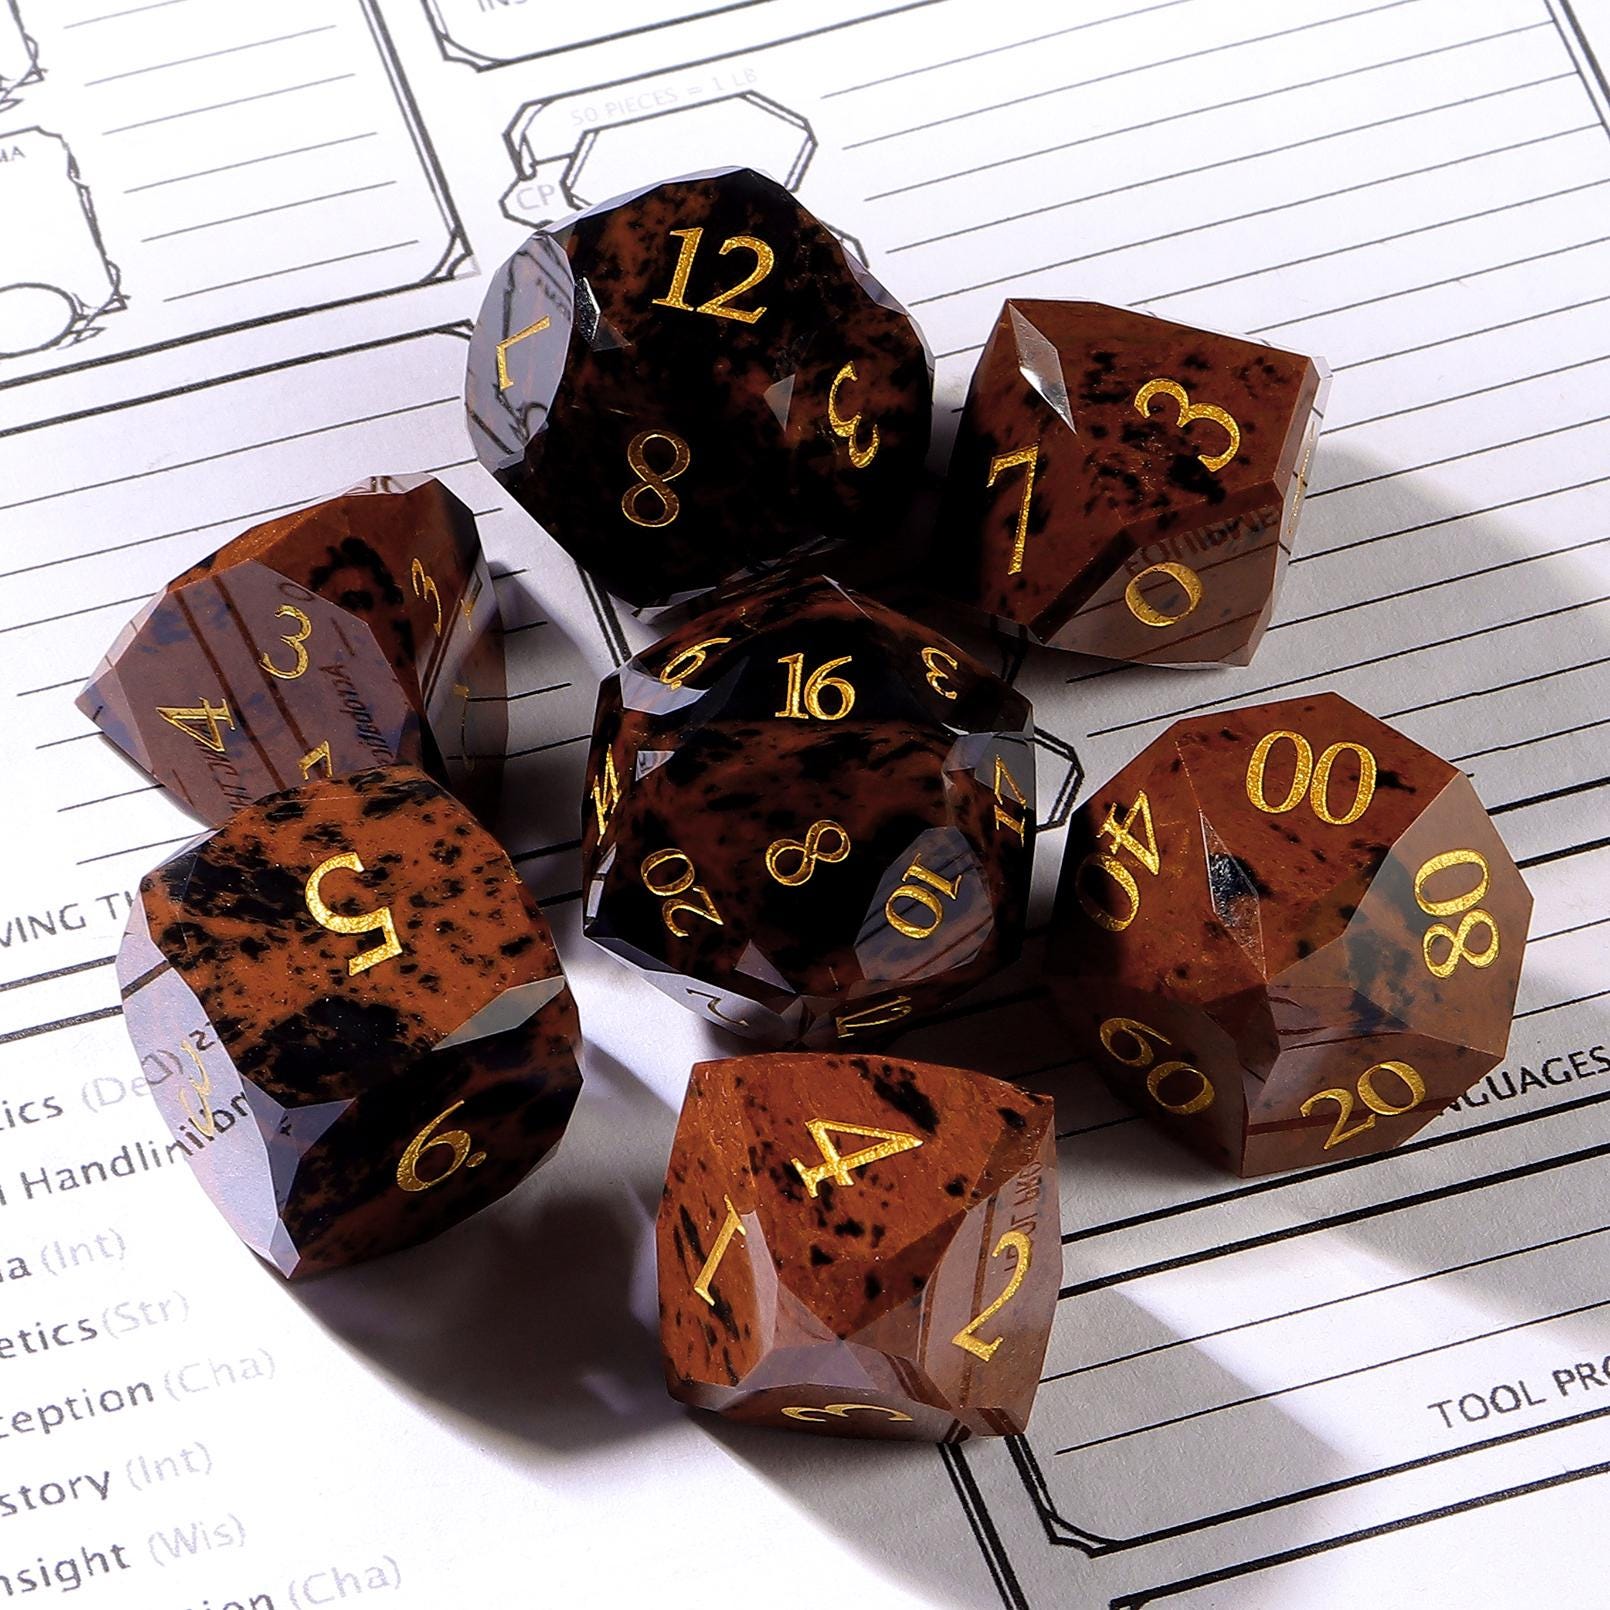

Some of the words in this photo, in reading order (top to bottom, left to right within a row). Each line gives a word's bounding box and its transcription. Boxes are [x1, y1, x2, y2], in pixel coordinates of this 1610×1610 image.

[603, 86, 679, 118] PIECES
[712, 75, 726, 93] 1
[731, 67, 758, 88] LB
[516, 184, 556, 211] CP
[652, 226, 775, 324] 12
[828, 360, 880, 468] 3
[1133, 377, 1241, 472] 3
[621, 430, 690, 528] 8
[986, 444, 1040, 576] 7
[411, 557, 442, 638] 3
[259, 604, 312, 680] 3
[920, 646, 958, 699] 3
[156, 697, 236, 753] 4
[774, 652, 855, 721] 16
[1245, 730, 1378, 826] 00
[765, 819, 851, 886] 8
[1074, 790, 1162, 933] 40
[305, 852, 403, 977] 5
[640, 848, 724, 938] 20
[884, 852, 963, 940] 10
[1413, 847, 1500, 979] 80
[1299, 1060, 1426, 1151] 20
[20, 1139, 183, 1200] Handlin
[791, 1118, 924, 1199] 4
[0, 1257, 32, 1282] a
[40, 1228, 126, 1276] (Int)
[693, 1193, 748, 1307] 1
[101, 1291, 190, 1339] (Str)
[951, 1231, 1032, 1363] 2
[163, 1348, 275, 1402] (Cha)
[781, 1404, 914, 1423] 3
[1427, 1380, 1547, 1428] TOOL
[126, 1442, 213, 1491] (Int)
[147, 1513, 246, 1567] (Wis)
[287, 1555, 402, 1610] (Cha)
